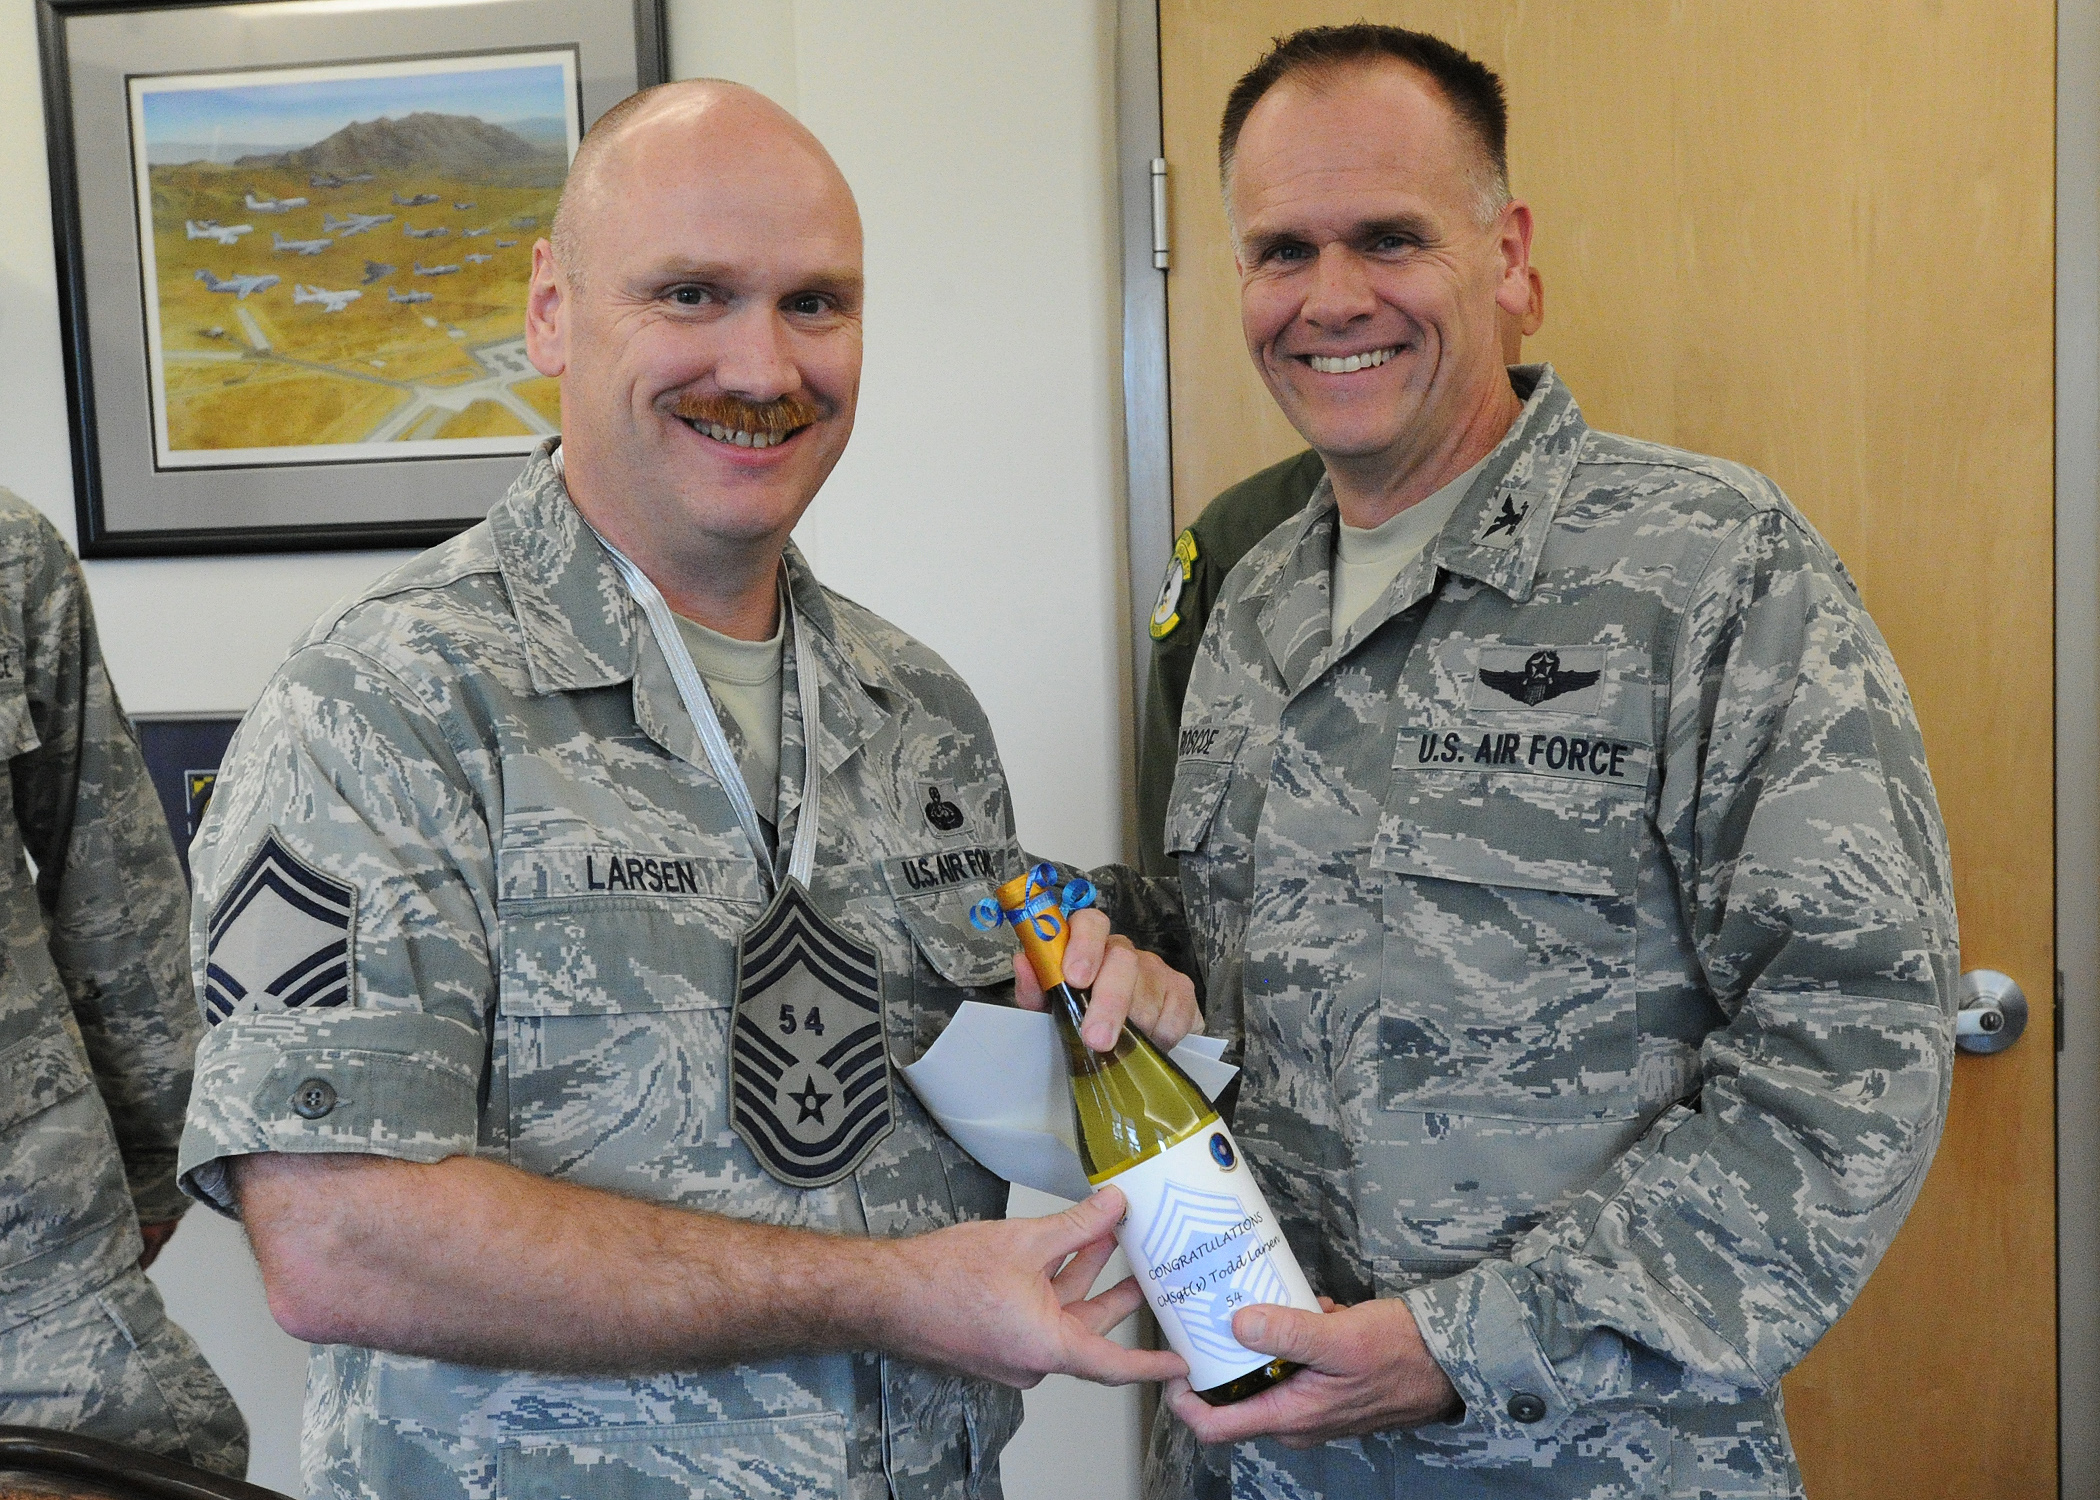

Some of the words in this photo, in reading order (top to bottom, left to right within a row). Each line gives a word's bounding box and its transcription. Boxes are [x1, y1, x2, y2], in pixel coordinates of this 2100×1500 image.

[1418, 732, 1464, 763] U.S.
[1474, 733, 1521, 764] AIR
[1528, 734, 1628, 778] FORCE
[586, 855, 698, 894] LARSEN
[901, 858, 939, 890] U.S.
[937, 852, 969, 884] AIR
[778, 1003, 825, 1037] 54
[1148, 1211, 1264, 1281] CONGRATULATIONS
[1208, 1255, 1248, 1284] Todd
[1246, 1235, 1281, 1262] Larsen
[1225, 1292, 1243, 1308] 54
